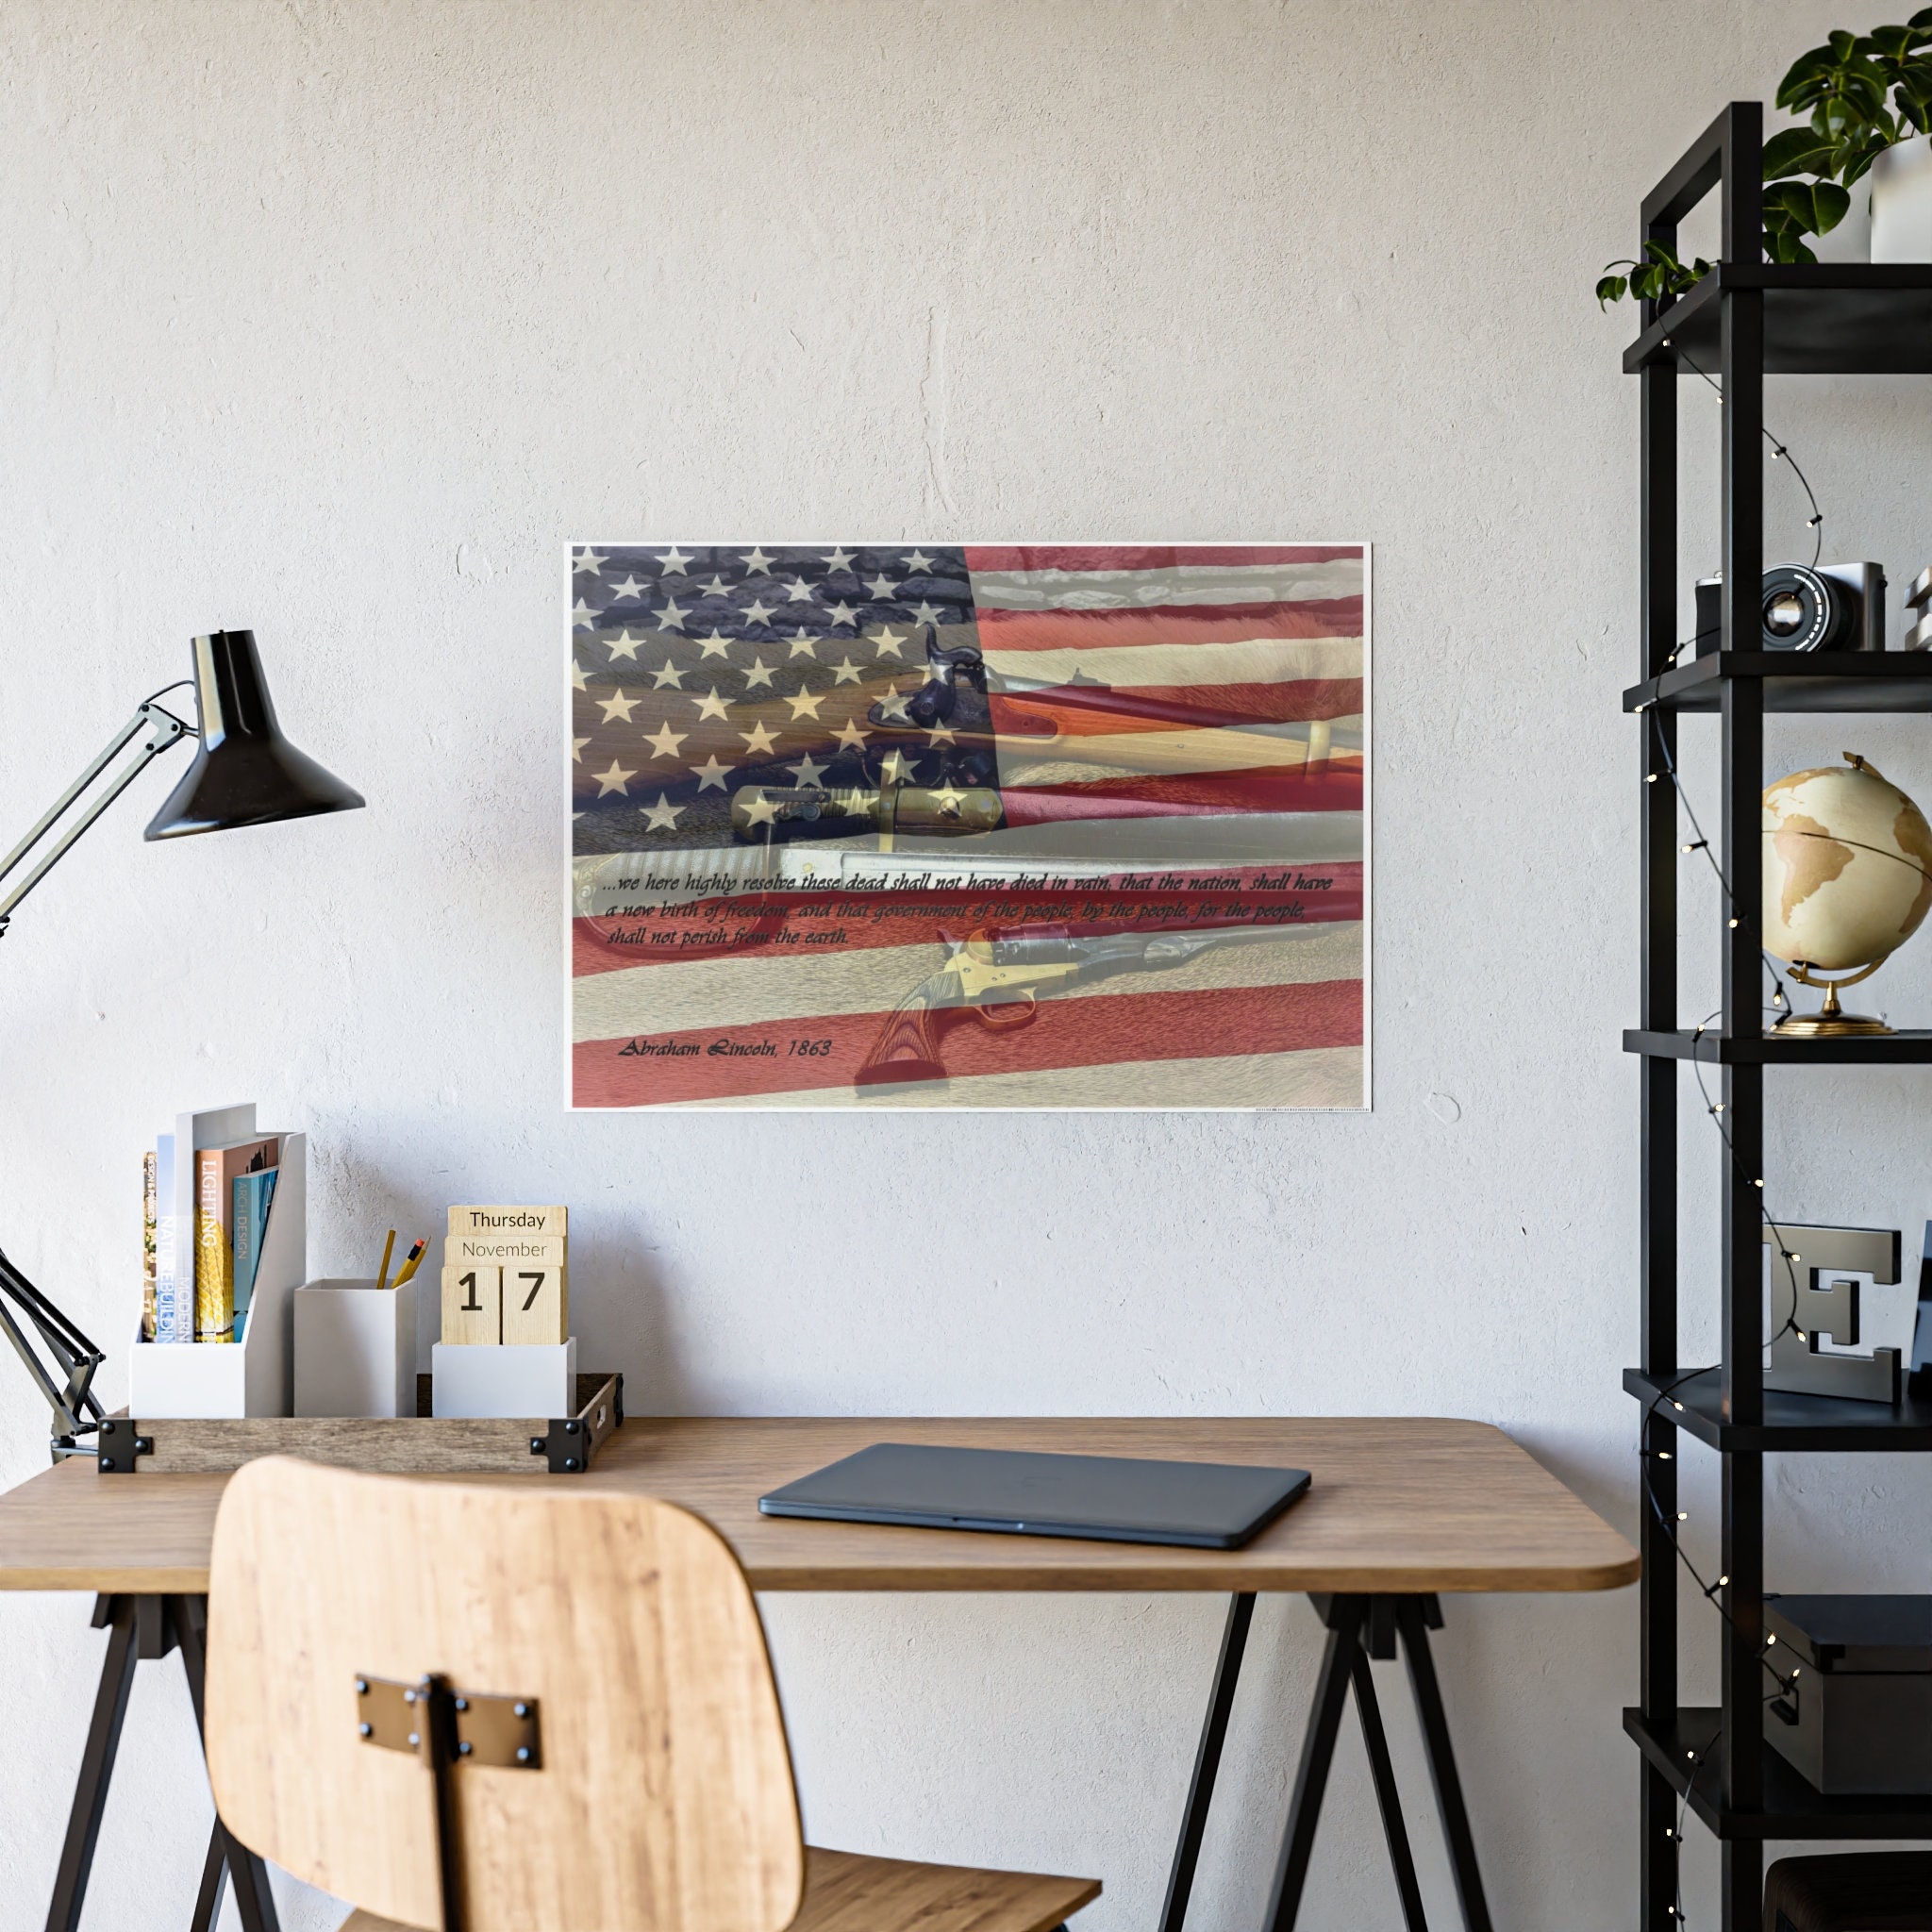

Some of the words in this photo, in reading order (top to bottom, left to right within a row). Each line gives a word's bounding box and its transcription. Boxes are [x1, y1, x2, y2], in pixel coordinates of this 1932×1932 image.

[602, 877, 640, 891] ...we
[645, 873, 679, 891] here
[684, 873, 737, 896] highly
[741, 873, 796, 891] resolve
[801, 873, 841, 891] these
[845, 873, 889, 891] dead
[891, 873, 931, 891] shall
[934, 876, 962, 891] not
[967, 873, 1006, 891] have
[1010, 873, 1048, 891] died
[1052, 875, 1069, 891] in
[1119, 873, 1154, 891] that
[1158, 873, 1184, 891] the
[1188, 875, 1241, 892] nation,
[1249, 873, 1291, 891] shall
[1292, 873, 1333, 891] have
[605, 905, 618, 918] a
[622, 905, 656, 918] new
[660, 900, 698, 918] birth
[704, 900, 726, 924] of
[721, 900, 790, 924] freedom,
[798, 900, 831, 918] and
[837, 900, 869, 918] that
[871, 905, 968, 924] government
[973, 900, 994, 924] of
[993, 900, 1019, 918] the
[1081, 900, 1104, 924] by
[1108, 900, 1136, 918] the
[1136, 900, 1188, 924] people,
[1191, 900, 1222, 924] for
[1224, 900, 1250, 918] the
[1252, 900, 1305, 924] people,
[608, 927, 646, 944] shall
[650, 930, 677, 944] not
[679, 927, 727, 950] perish
[726, 927, 770, 950] from
[775, 927, 801, 944] the
[805, 927, 848, 944] earth.
[618, 1039, 700, 1056] Abraham
[707, 1039, 778, 1058] Lincoln,
[787, 1039, 832, 1057] 1863
[201, 1160, 217, 1247] LIGHTING
[237, 1182, 248, 1215] ARCH
[469, 1211, 546, 1230] Thursday
[237, 1217, 248, 1259] DESIGN
[462, 1241, 547, 1257] November
[177, 1276, 191, 1342] MODERN
